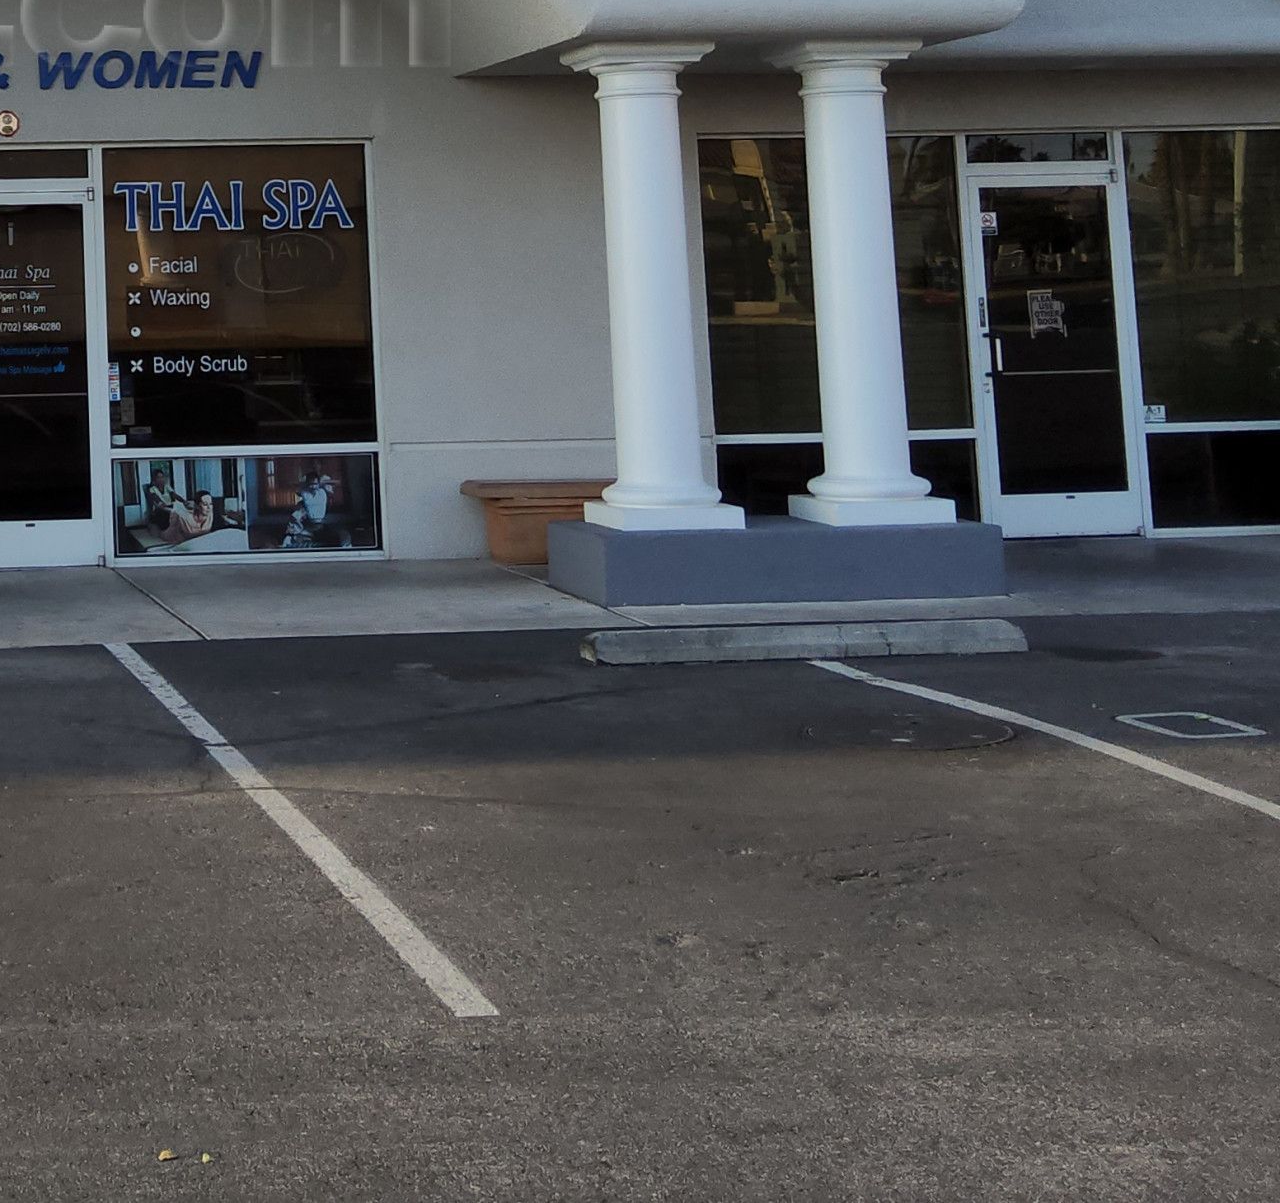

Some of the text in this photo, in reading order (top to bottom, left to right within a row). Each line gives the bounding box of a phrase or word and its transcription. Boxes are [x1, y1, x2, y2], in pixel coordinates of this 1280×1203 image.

[37, 50, 263, 91] WOMEN
[113, 178, 355, 232] THAI SPA
[25, 264, 51, 282] Spa
[149, 256, 198, 274] Facial
[19, 290, 40, 301] Daily
[150, 288, 211, 309] Waxing
[1, 306, 14, 314] am
[22, 304, 31, 313] 11
[33, 305, 47, 314] pm
[0, 321, 21, 333] (702)
[22, 322, 62, 332] 586-0280
[153, 355, 248, 377] Body Scrub
